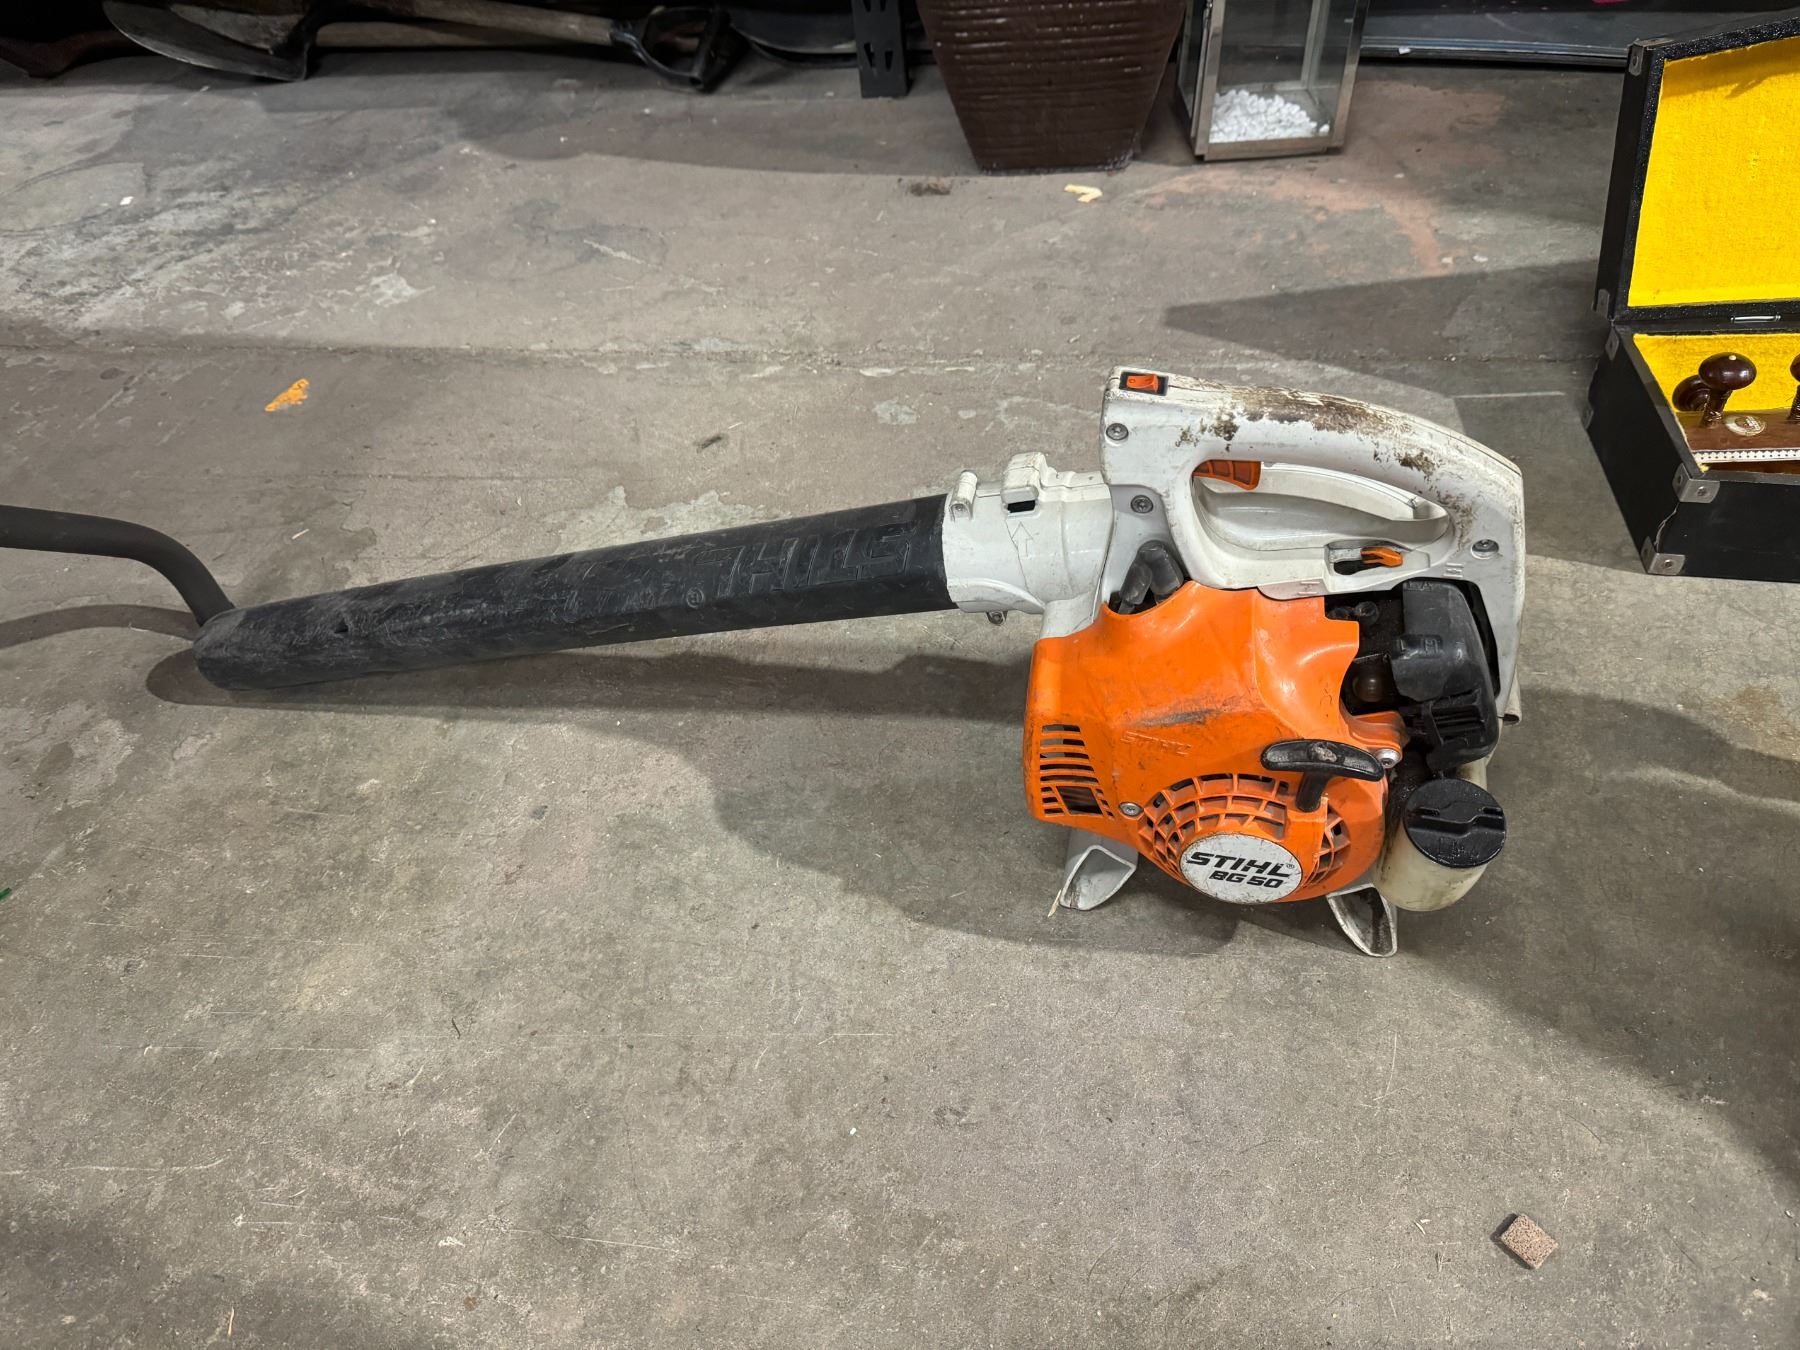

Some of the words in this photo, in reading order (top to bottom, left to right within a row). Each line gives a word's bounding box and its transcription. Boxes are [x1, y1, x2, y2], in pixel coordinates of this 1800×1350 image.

[1186, 851, 1291, 878] STIHL
[1209, 870, 1247, 883] BG
[1246, 875, 1284, 889] 50
